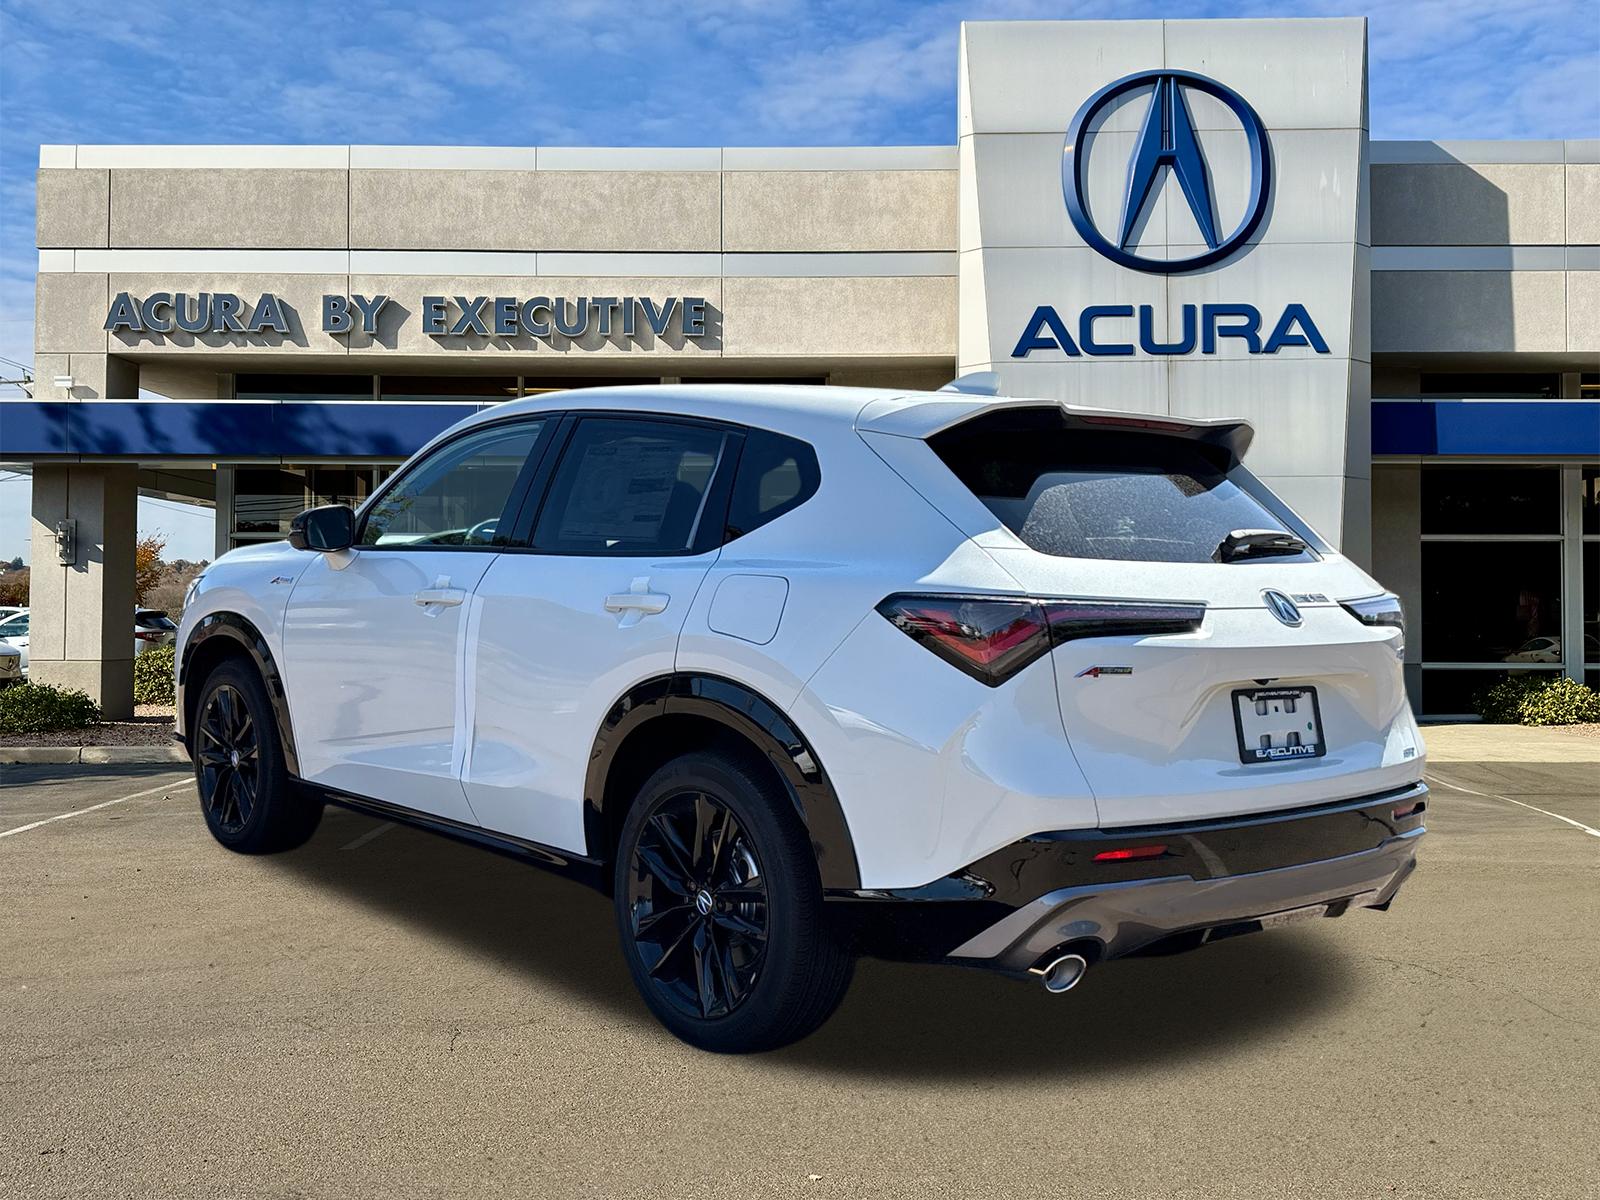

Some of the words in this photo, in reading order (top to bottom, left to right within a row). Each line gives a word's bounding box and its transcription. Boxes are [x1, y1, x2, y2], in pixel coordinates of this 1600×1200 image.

[103, 291, 290, 333] ACURA
[322, 294, 391, 334] BY
[422, 296, 706, 337] EXECUTIVE
[1010, 303, 1332, 357] ACURA
[1255, 744, 1316, 758] EXECUTIVE
